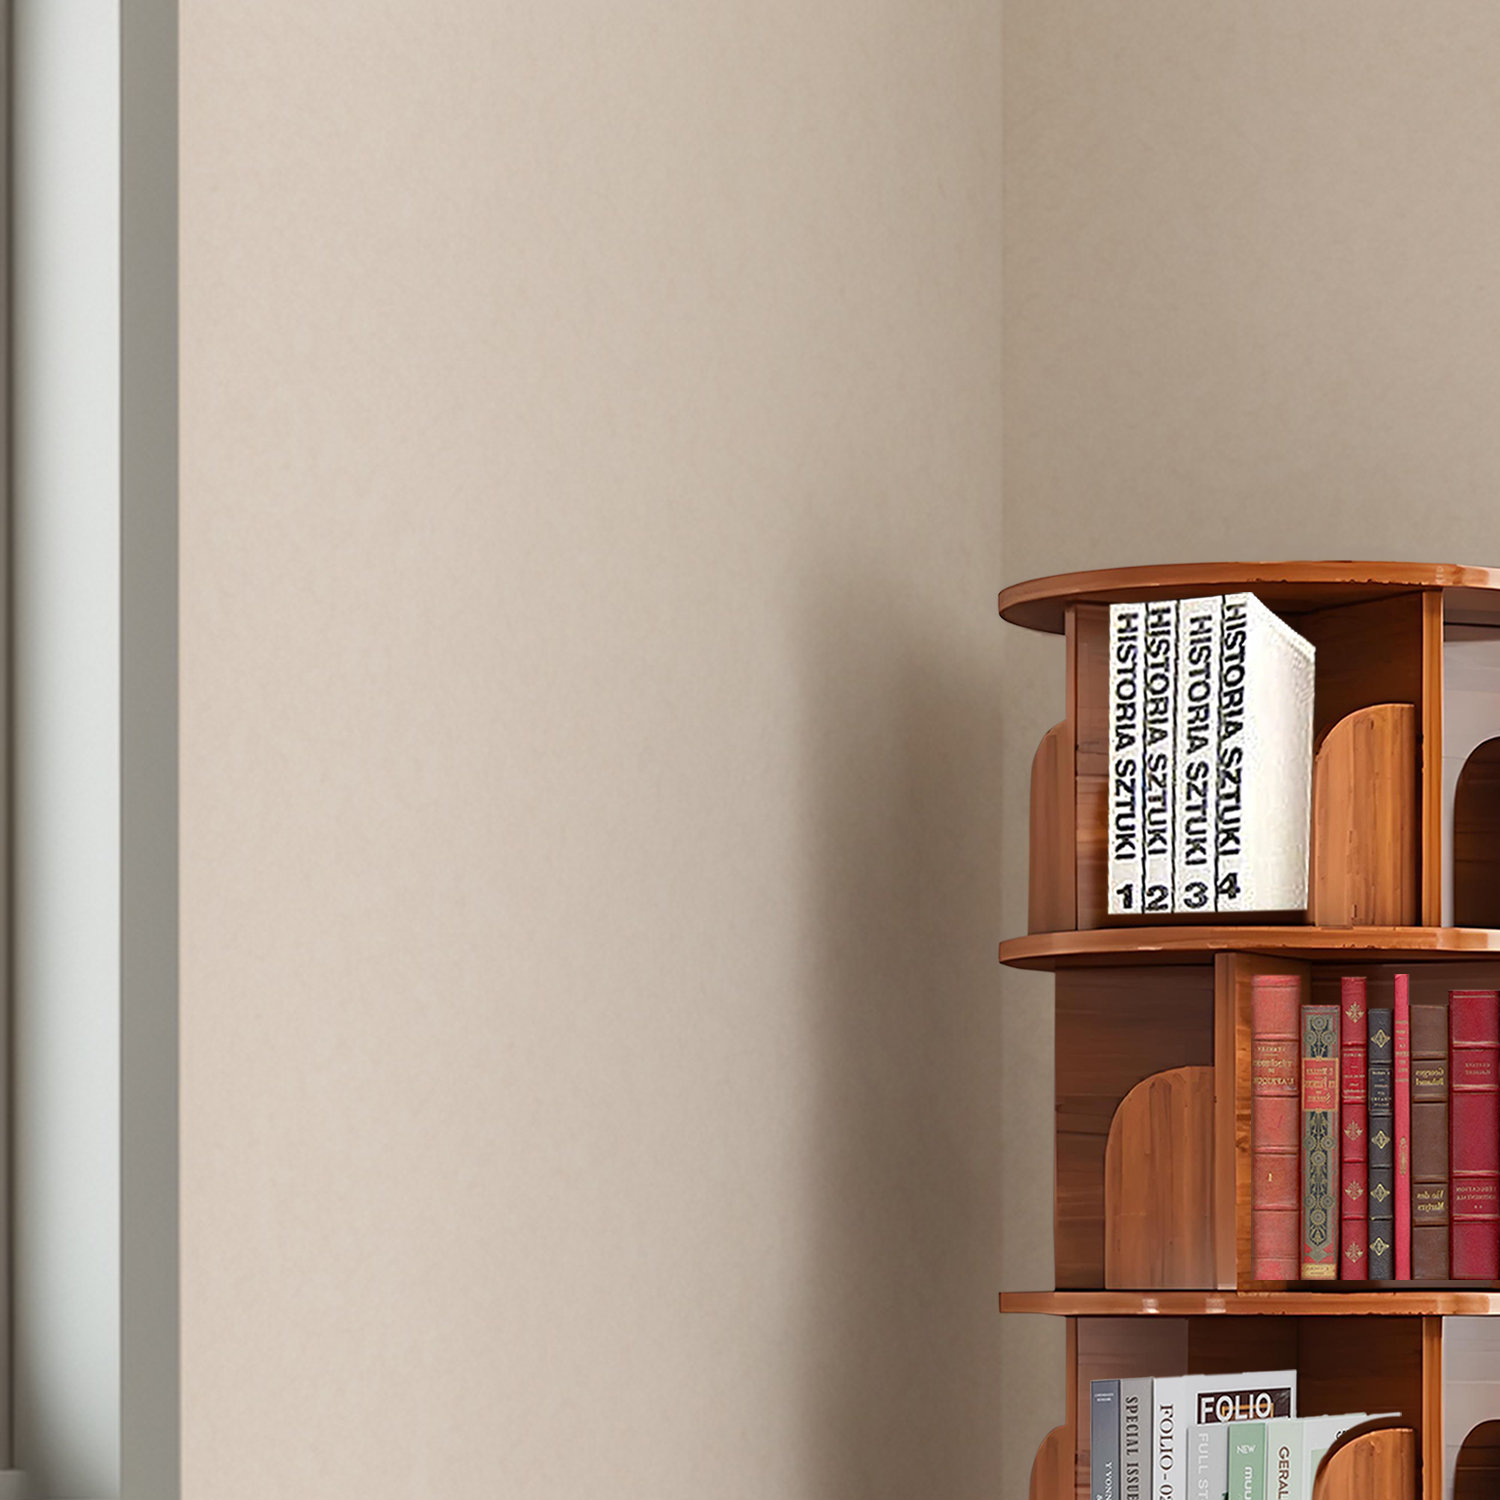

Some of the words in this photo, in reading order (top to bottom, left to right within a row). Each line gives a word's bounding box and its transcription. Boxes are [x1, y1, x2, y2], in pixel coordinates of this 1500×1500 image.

[1115, 613, 1138, 752] HISTORIA
[1148, 606, 1171, 746] HISTORIA
[1187, 615, 1213, 755] HISTORIA
[1222, 603, 1247, 740] HISTORIA
[1115, 759, 1136, 860] SZTUKI
[1147, 753, 1168, 855] SZTUKI
[1185, 762, 1209, 866] SZTUKI
[1218, 747, 1243, 856] SZTUKI
[1116, 884, 1133, 909] 1
[1146, 885, 1168, 912] 2
[1184, 881, 1209, 909] 3
[1218, 872, 1241, 899] 4
[1125, 1396, 1139, 1456] SPECIAL
[1200, 1392, 1272, 1423] FOLIO
[1126, 1462, 1139, 1500] ISSUE
[1198, 1432, 1209, 1475] FULL
